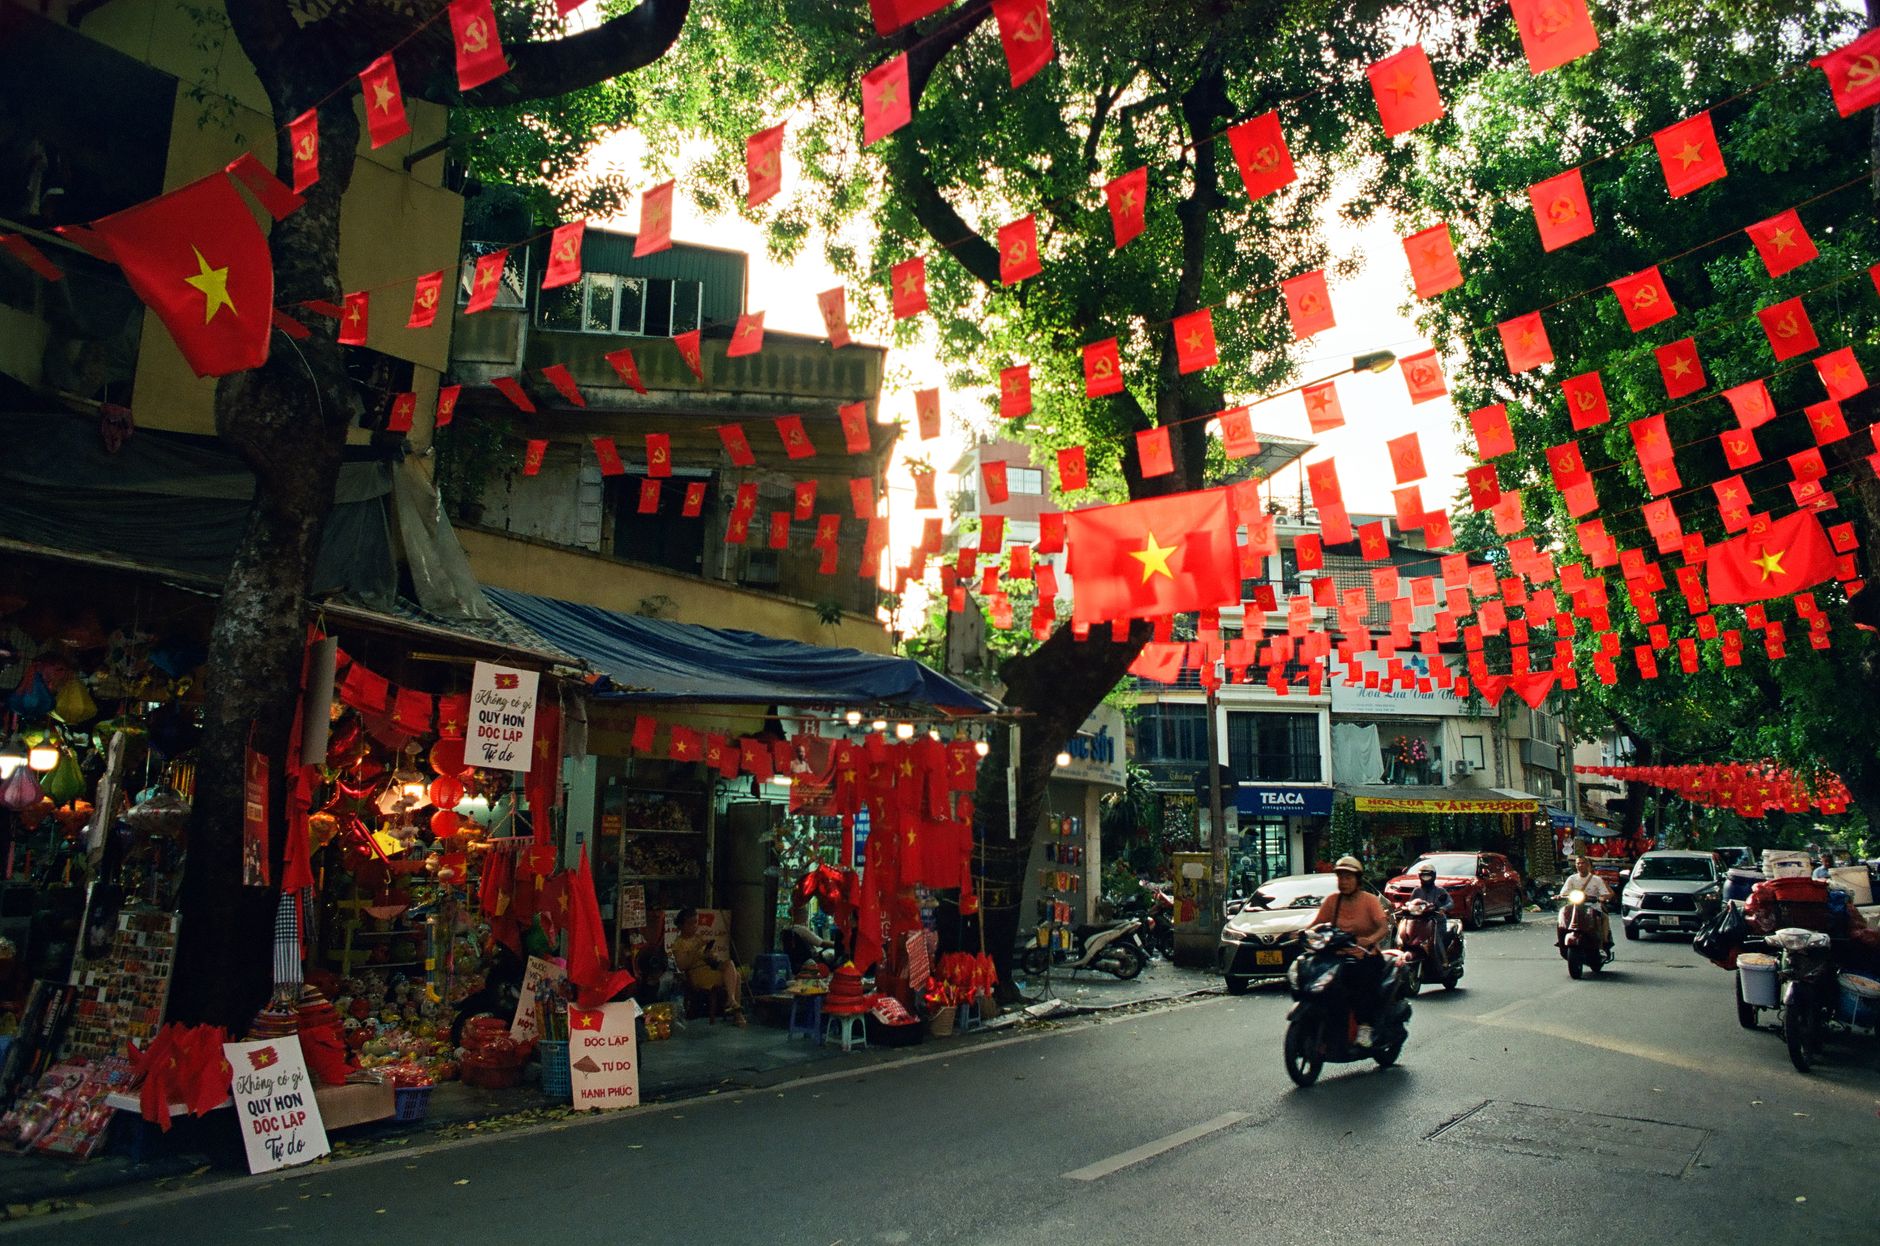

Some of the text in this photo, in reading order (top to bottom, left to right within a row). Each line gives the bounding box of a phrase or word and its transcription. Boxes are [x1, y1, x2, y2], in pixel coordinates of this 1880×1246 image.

[498, 743, 515, 762] do
[1259, 792, 1305, 805] TEACA
[616, 1061, 631, 1072] DO
[287, 1130, 306, 1156] do
